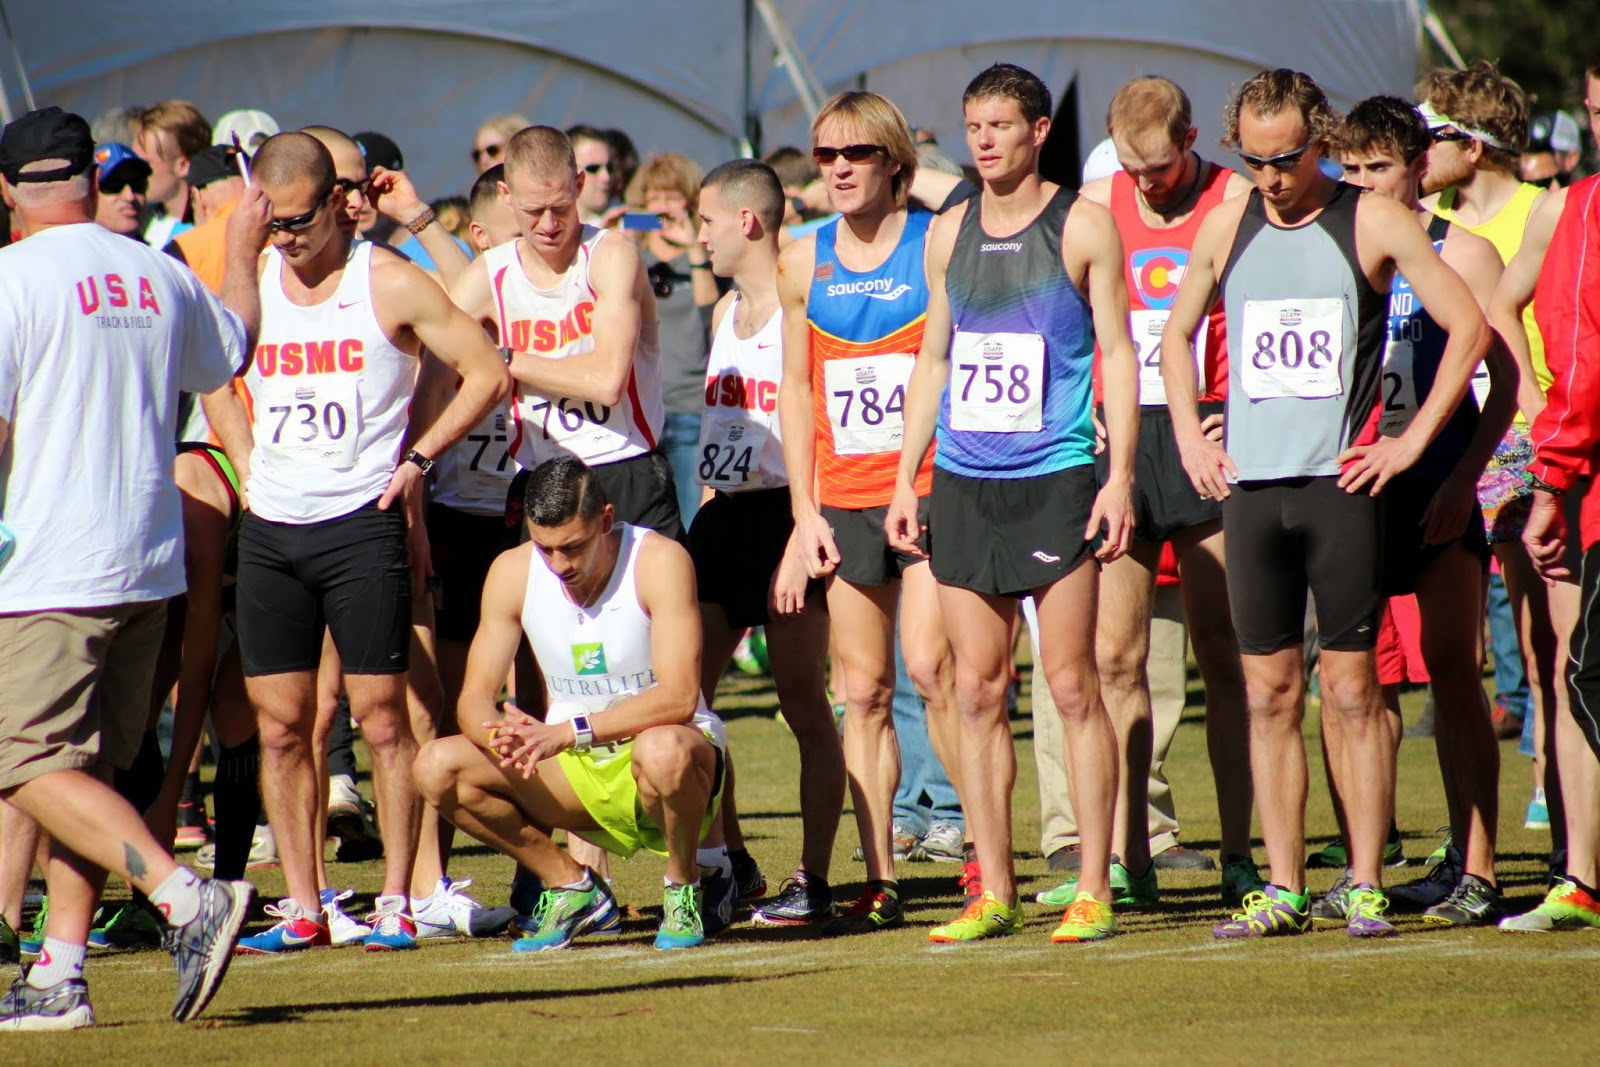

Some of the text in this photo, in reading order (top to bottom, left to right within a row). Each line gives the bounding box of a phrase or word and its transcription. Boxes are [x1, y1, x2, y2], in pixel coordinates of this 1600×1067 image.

[980, 242, 1023, 252] saucony
[76, 273, 161, 316] USA
[827, 277, 894, 297] saucony
[95, 316, 152, 329] TRACK & FIELD
[511, 301, 594, 353] USMC
[256, 338, 364, 378] USMC
[1133, 340, 1163, 377] 4
[1252, 330, 1333, 370] 808
[705, 374, 778, 413] USMC
[959, 363, 1031, 404] 758
[269, 401, 347, 444] 730
[532, 397, 610, 440] 760
[833, 384, 906, 428] 784
[699, 443, 753, 481] 824
[546, 668, 657, 695] UTRILIT
